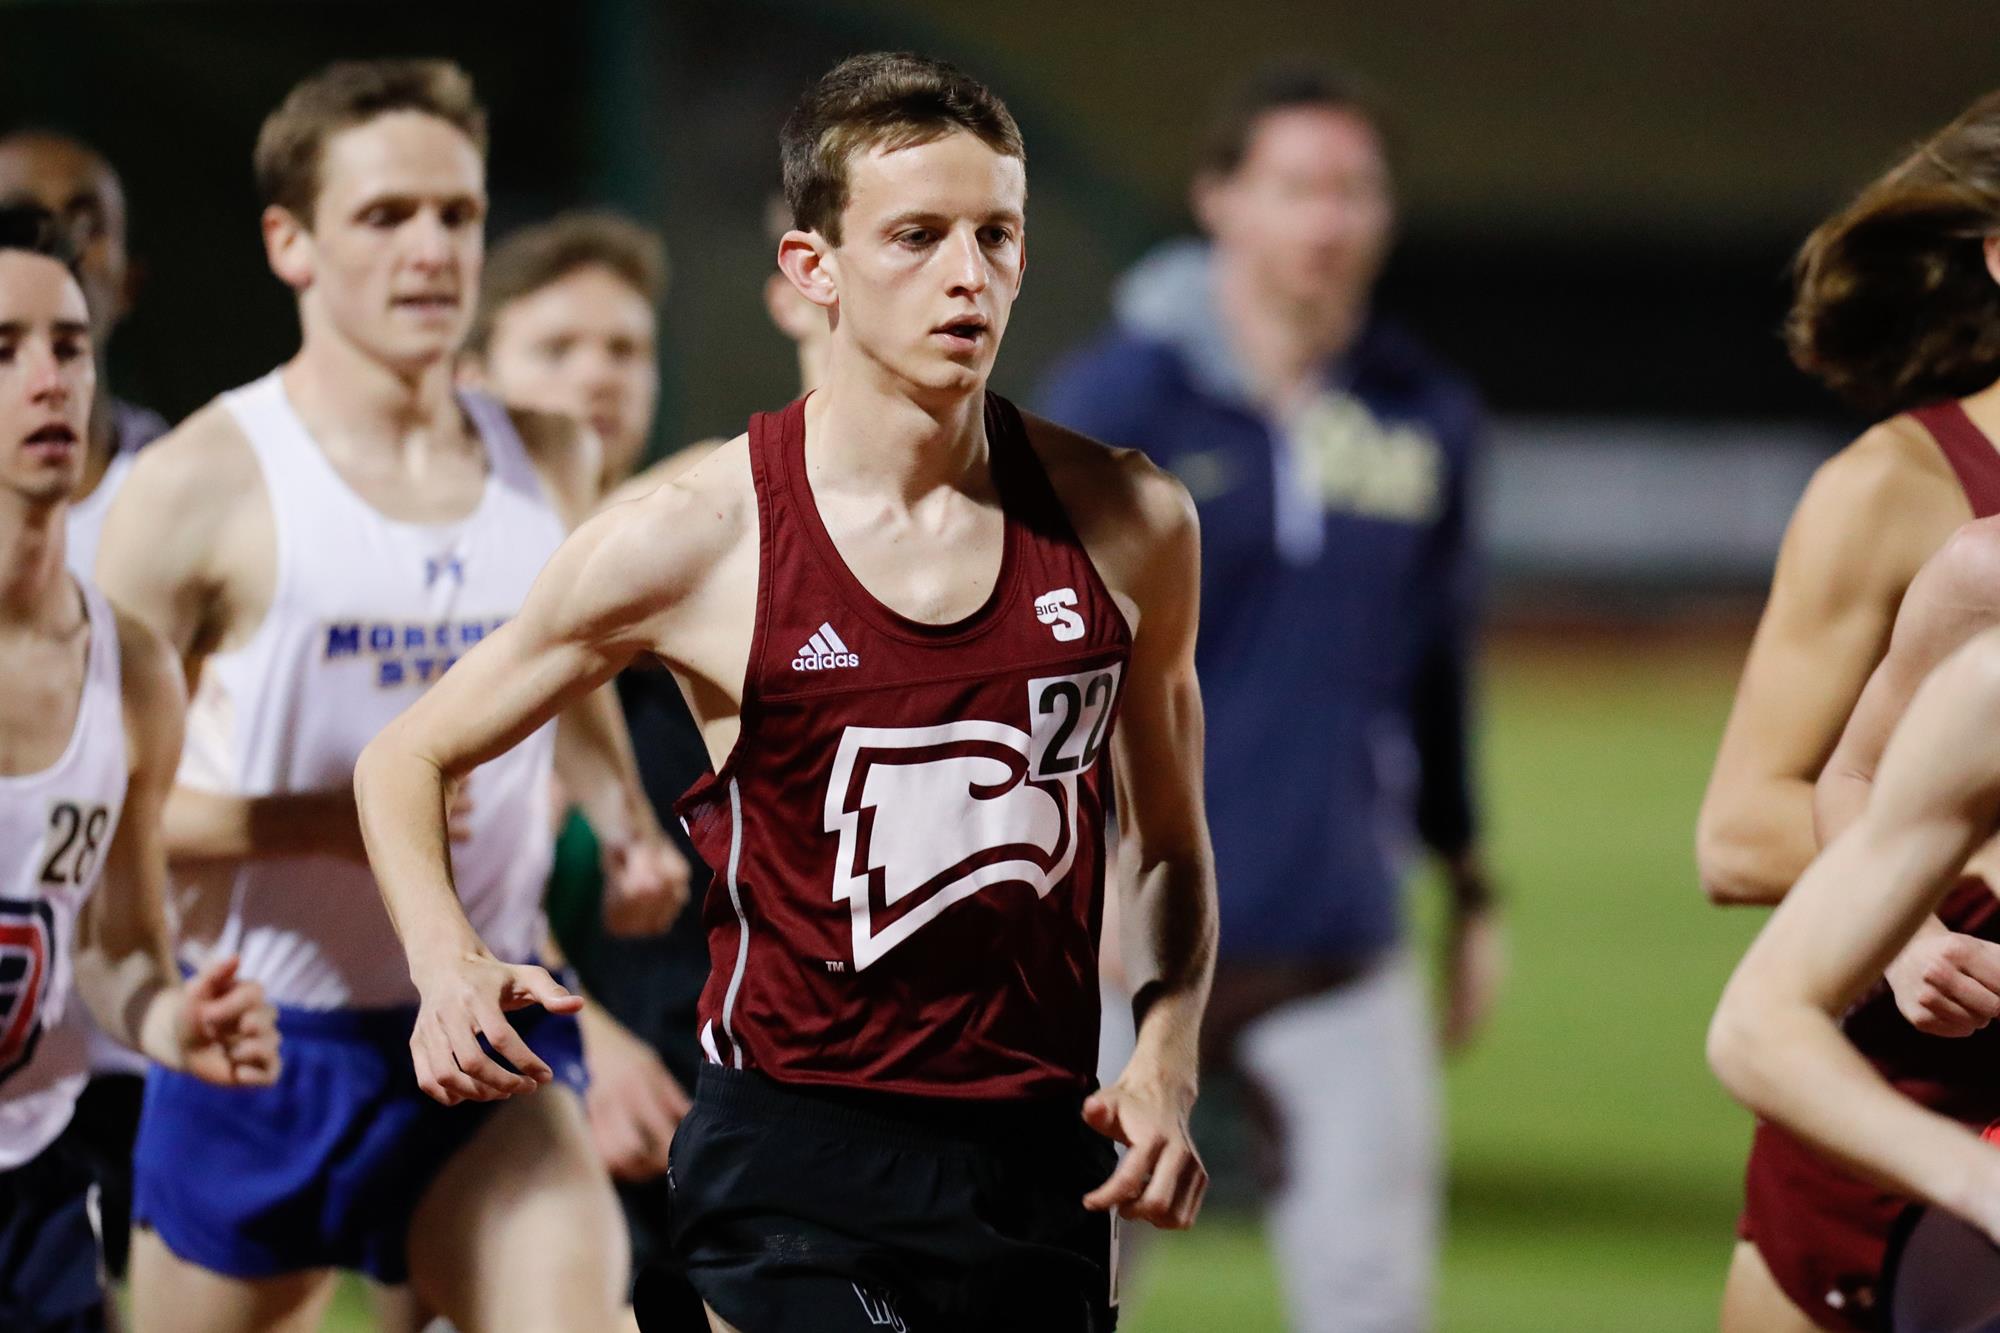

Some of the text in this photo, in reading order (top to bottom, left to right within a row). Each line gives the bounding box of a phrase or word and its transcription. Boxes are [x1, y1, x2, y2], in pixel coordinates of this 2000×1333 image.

[791, 651, 859, 671] adidas
[1038, 672, 1113, 776] 22
[40, 802, 107, 884] 28
[825, 960, 845, 972] TM
